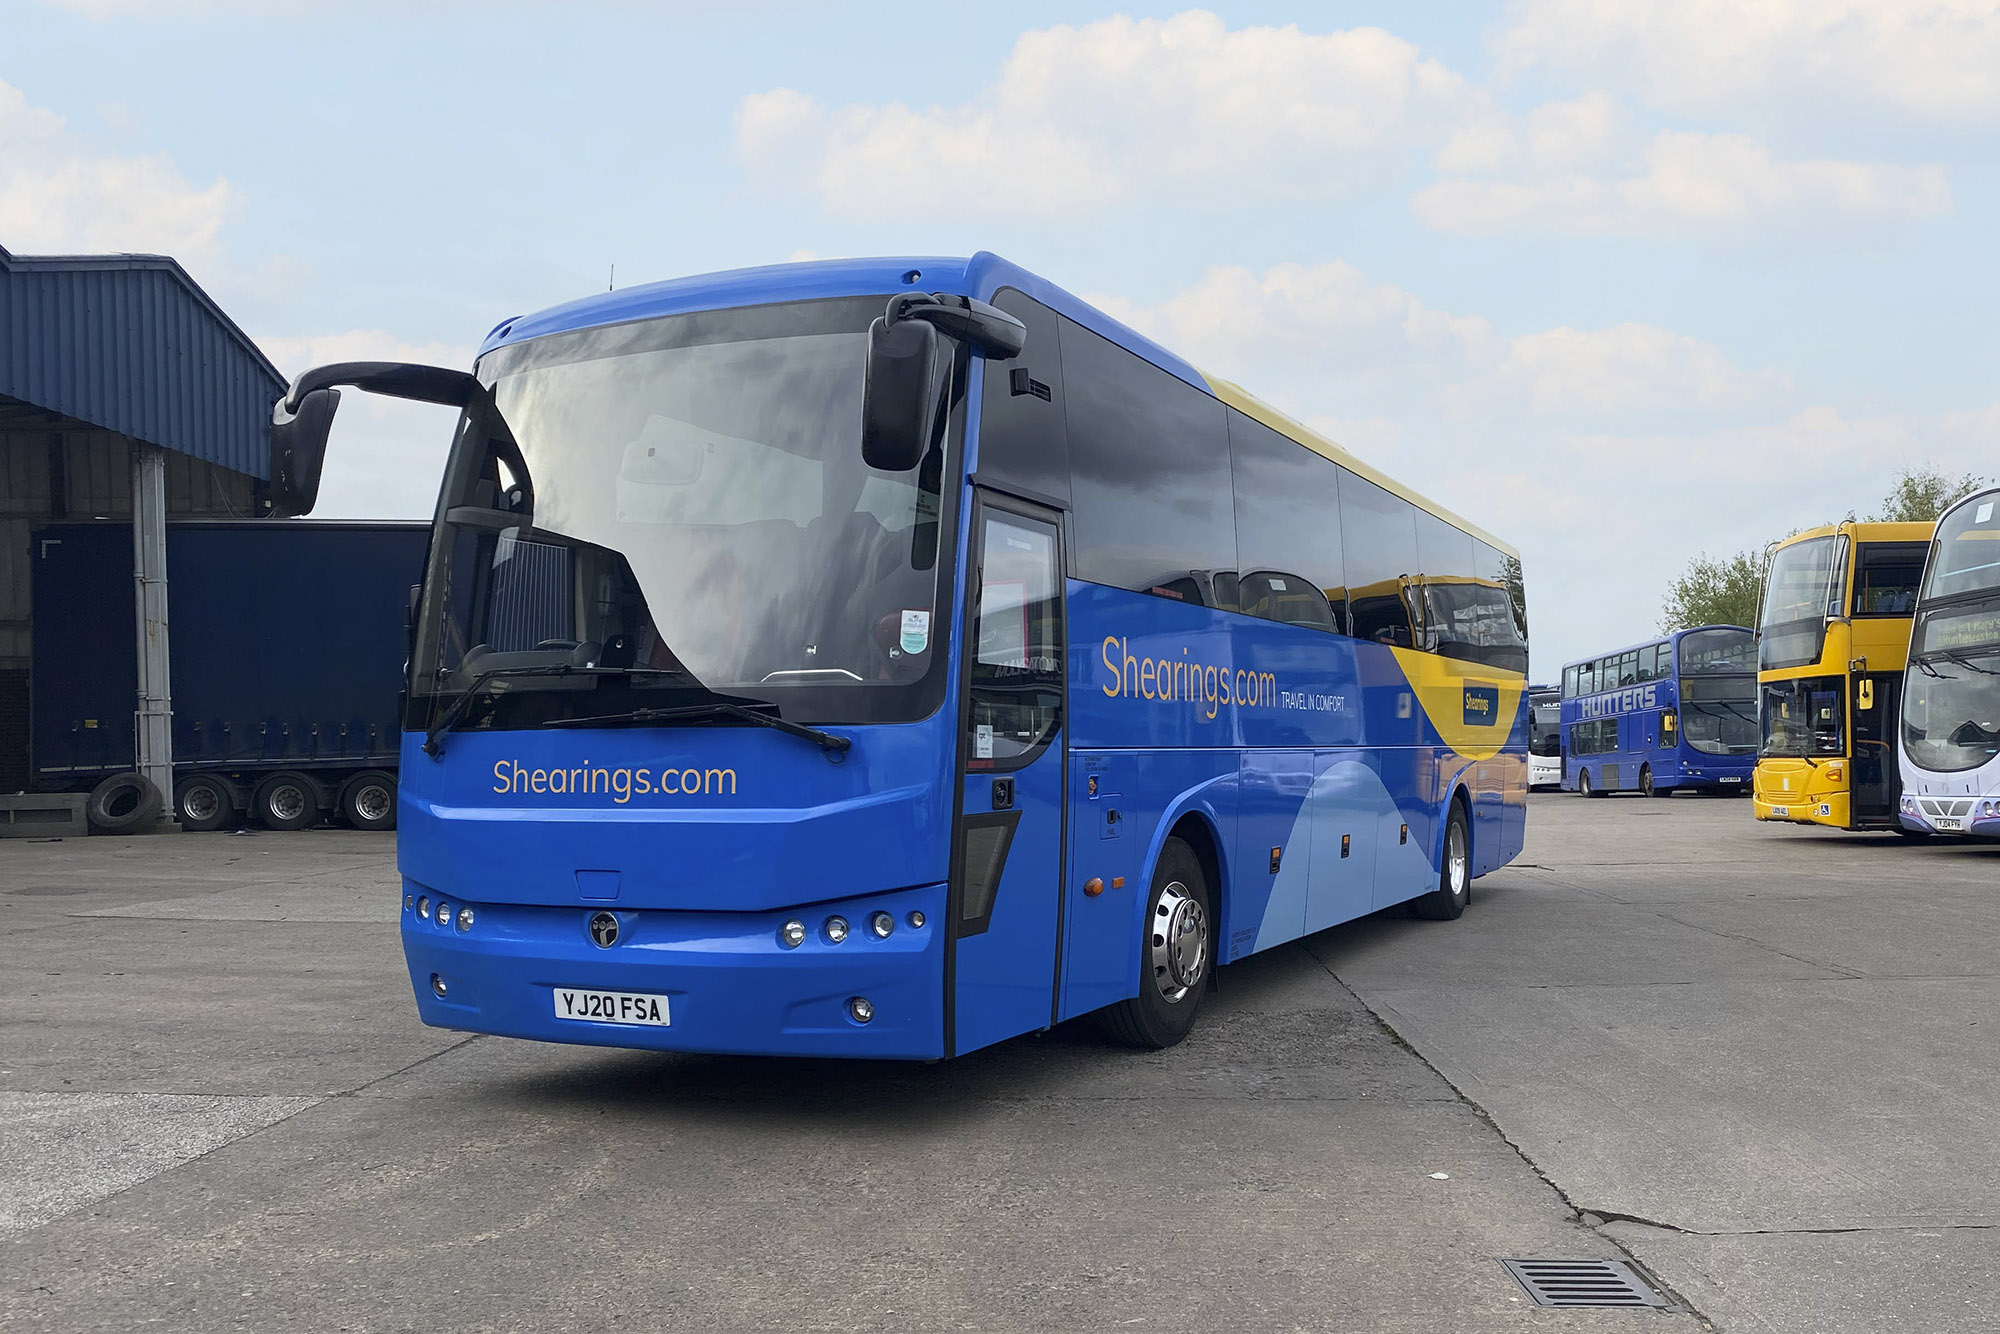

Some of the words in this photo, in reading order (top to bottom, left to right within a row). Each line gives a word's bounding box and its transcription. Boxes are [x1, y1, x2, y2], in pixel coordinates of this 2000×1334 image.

[1102, 635, 1276, 720] Shearings.com
[1281, 691, 1307, 710] TRAVEL
[1308, 694, 1315, 710] IN
[1316, 694, 1345, 712] COMFORT
[1466, 692, 1489, 715] Shearings
[1581, 685, 1656, 718] HUNTERS
[493, 759, 737, 803] Shearings.com
[562, 992, 616, 1018] YJ20
[620, 996, 661, 1021] FSA
